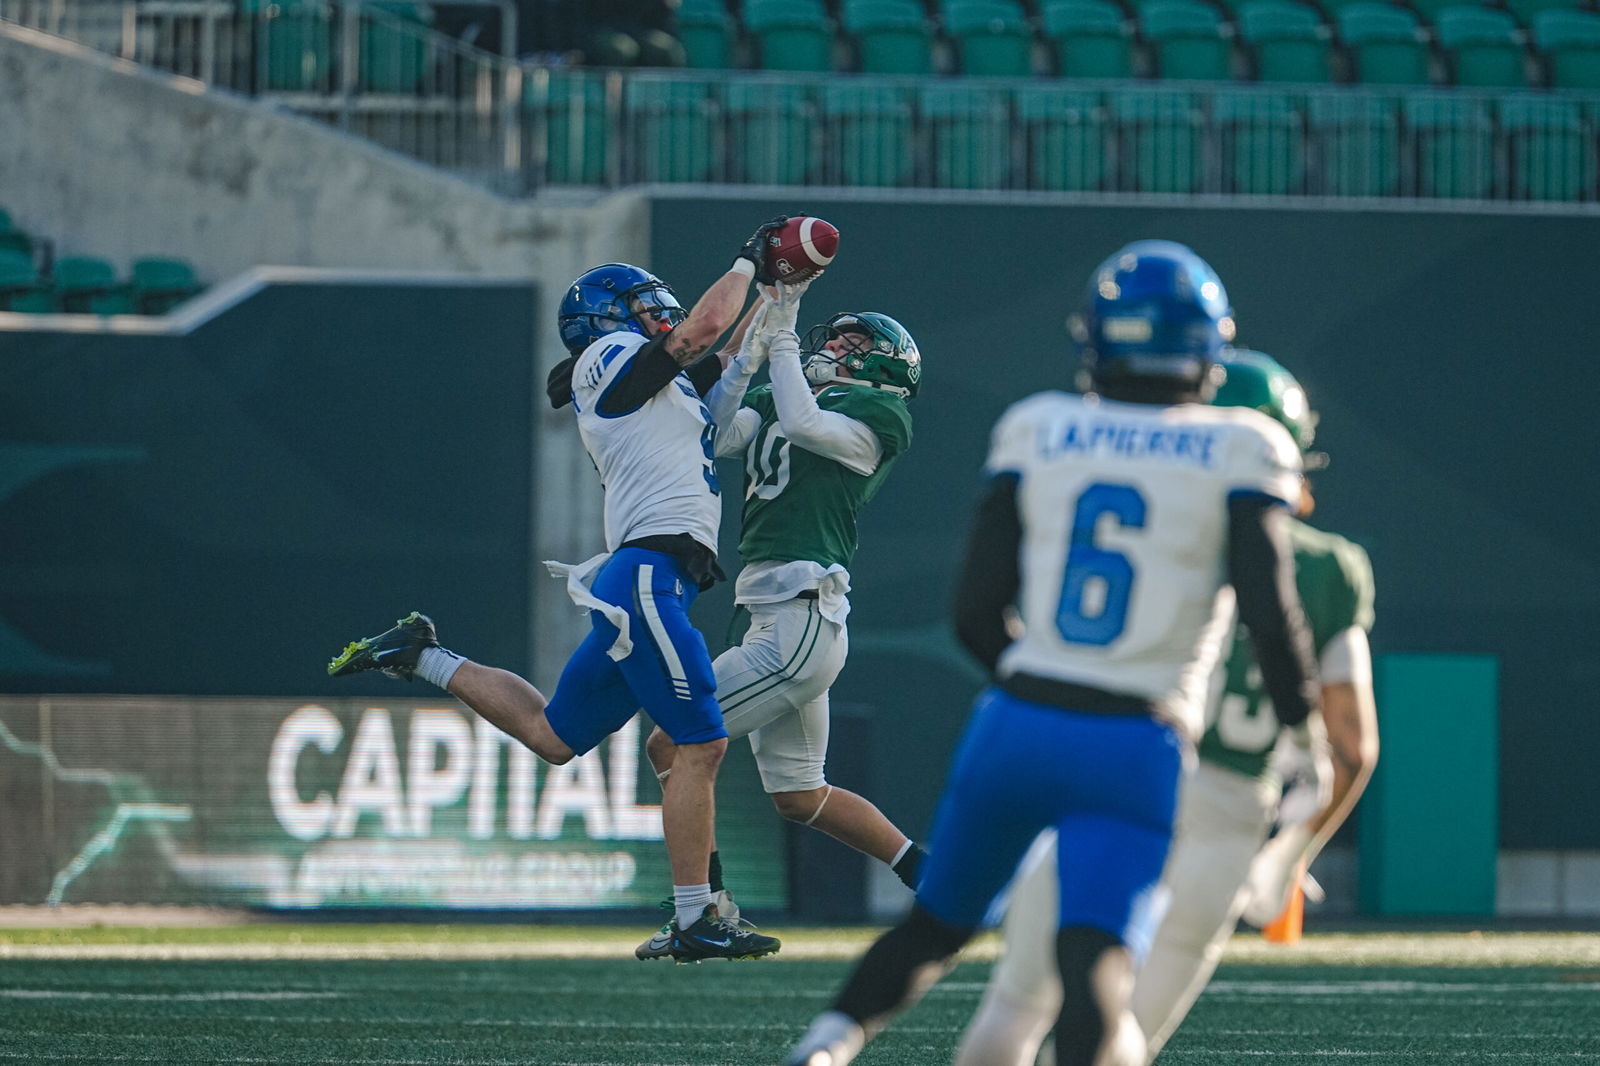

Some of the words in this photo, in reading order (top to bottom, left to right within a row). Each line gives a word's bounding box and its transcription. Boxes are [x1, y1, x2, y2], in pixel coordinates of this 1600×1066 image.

[745, 420, 791, 501] 10
[1055, 482, 1146, 646] 6
[267, 704, 664, 843] CAPITAL
